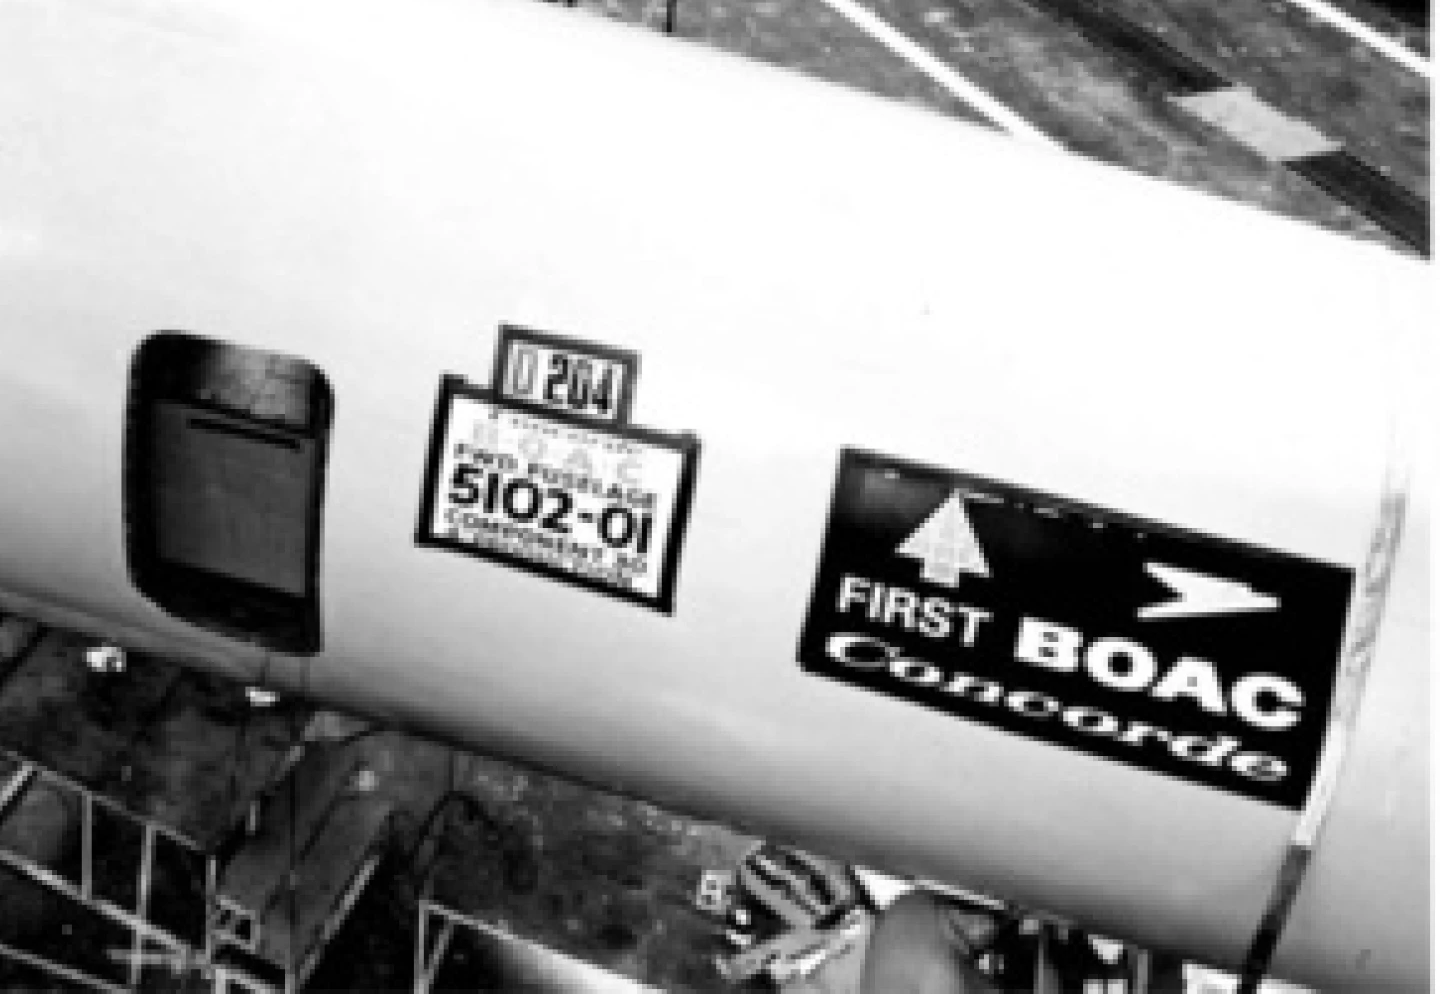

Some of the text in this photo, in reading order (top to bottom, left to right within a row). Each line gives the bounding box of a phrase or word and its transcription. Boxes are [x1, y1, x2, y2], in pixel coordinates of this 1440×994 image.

[543, 352, 614, 415] 204
[448, 462, 653, 554] 5102-01
[825, 632, 1288, 782] Concorde
[836, 572, 1306, 731] FIRST BOAC
